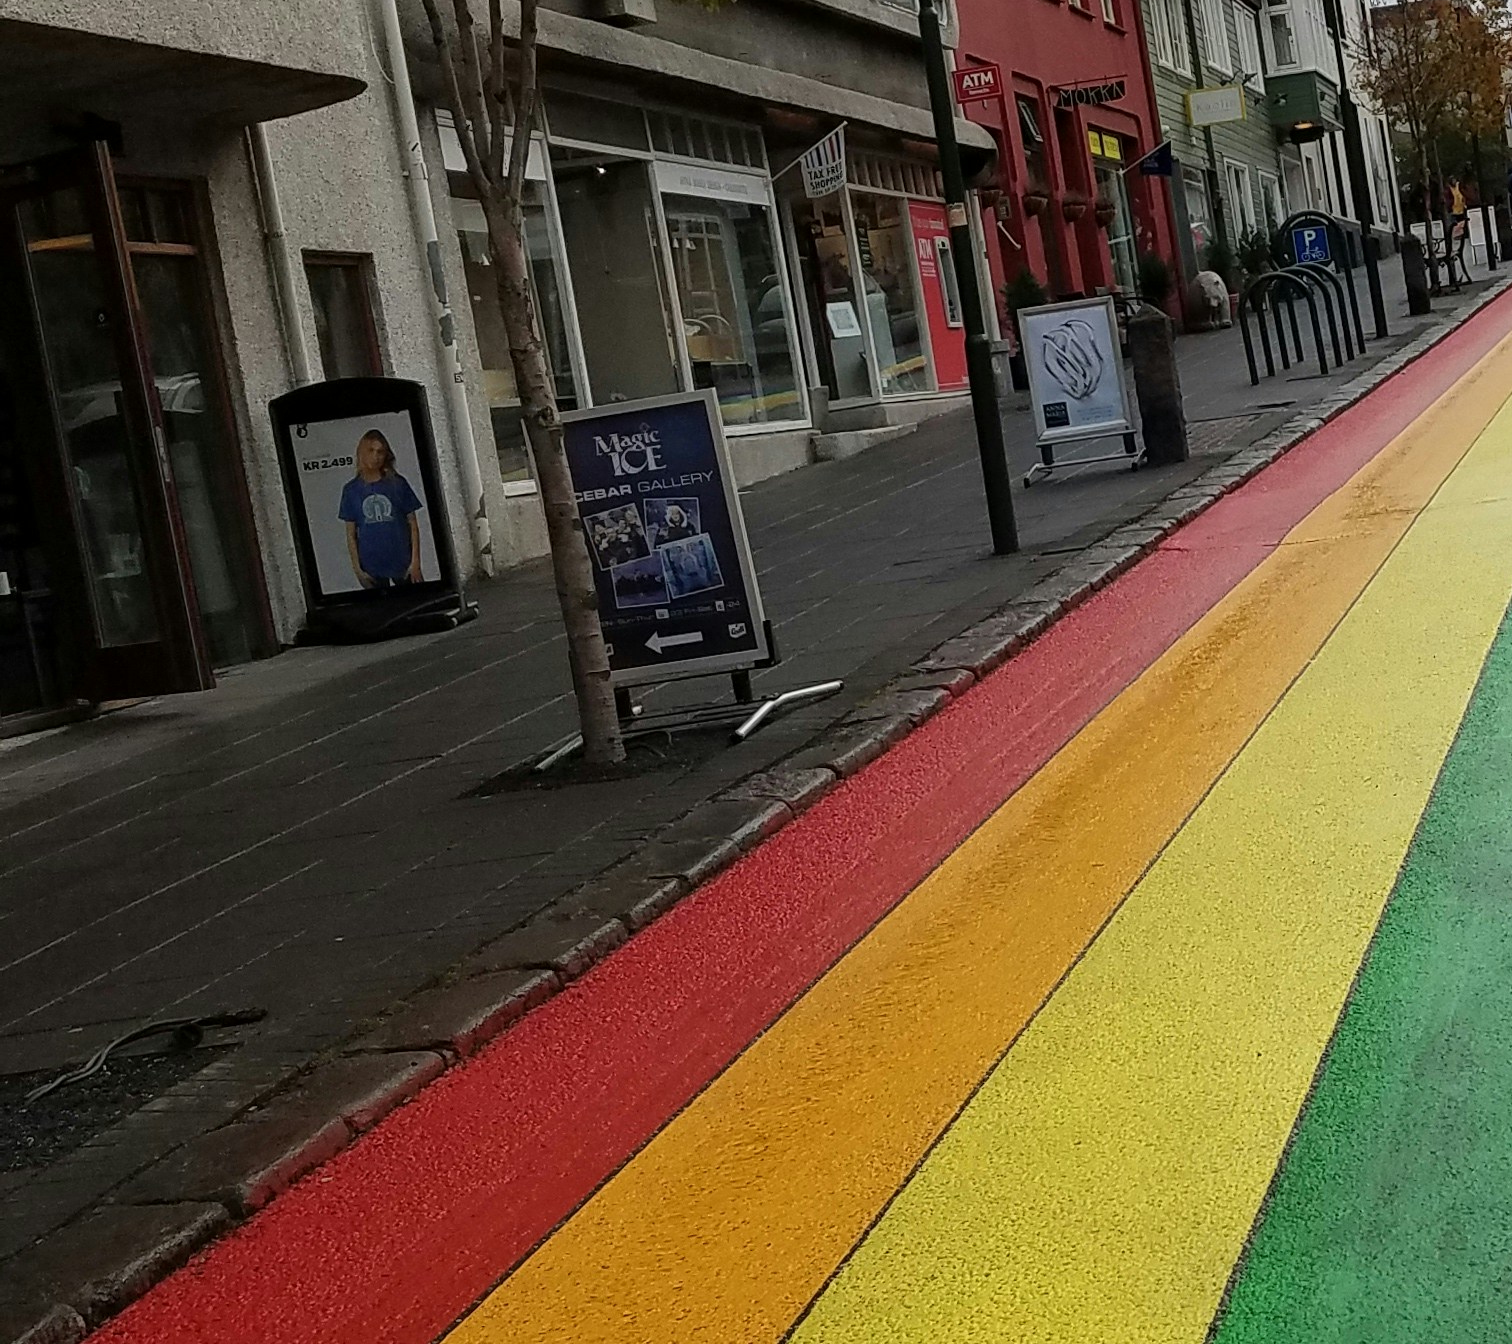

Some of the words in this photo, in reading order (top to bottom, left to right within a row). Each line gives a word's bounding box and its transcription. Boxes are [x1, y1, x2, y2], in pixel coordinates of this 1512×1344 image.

[962, 71, 995, 89] ATM
[1059, 84, 1124, 108] MOKKA
[807, 169, 824, 181] TAX
[810, 170, 844, 190] SHOPPING
[1303, 230, 1317, 247] P
[592, 430, 661, 456] Magic
[303, 461, 320, 471] KR
[321, 456, 353, 468] 2.499
[608, 444, 667, 477] ICE
[574, 484, 633, 502] CEBAR
[637, 470, 714, 493] GALLERY
